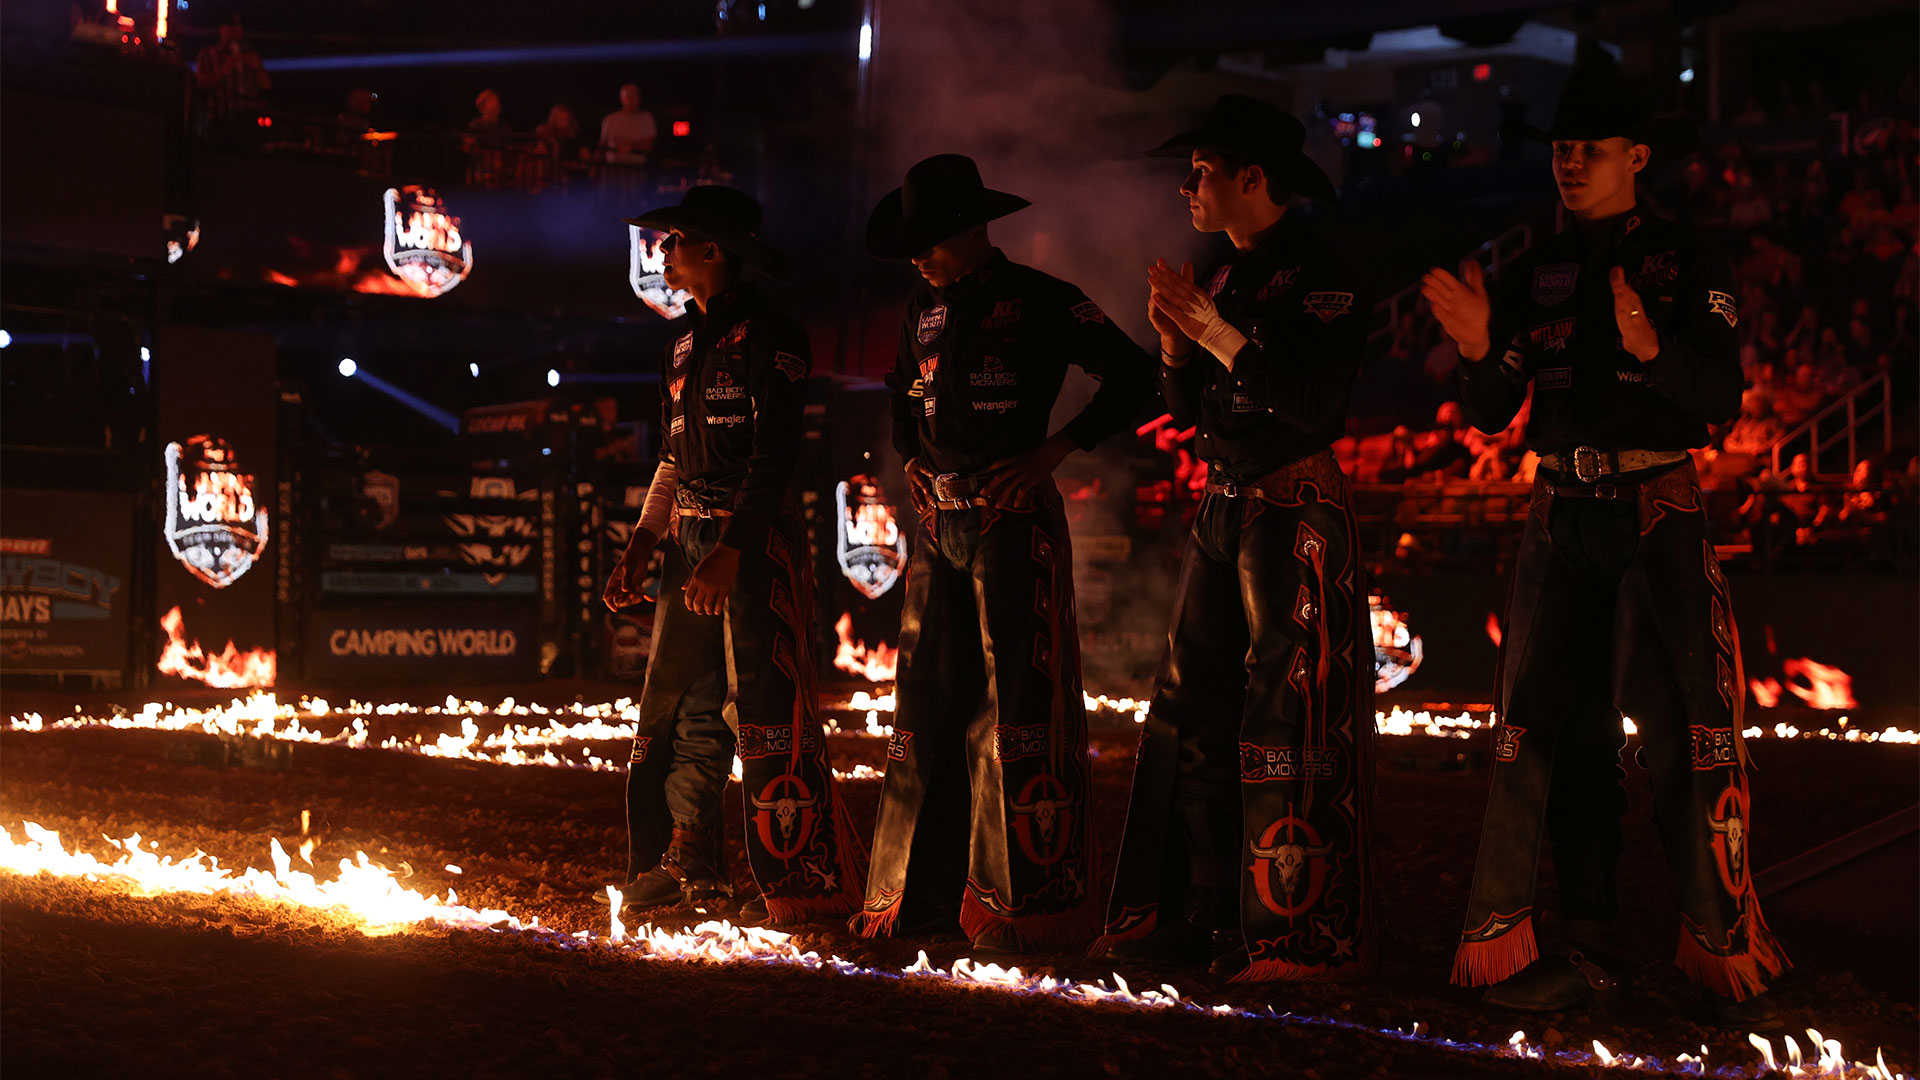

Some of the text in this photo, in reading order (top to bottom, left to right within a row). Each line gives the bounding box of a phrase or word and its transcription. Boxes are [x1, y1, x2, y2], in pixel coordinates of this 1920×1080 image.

[705, 386, 724, 394] BAD
[972, 400, 1019, 415] Wrangler
[706, 413, 747, 429] Wrangler
[179, 488, 255, 522] WORLD
[329, 628, 518, 657] CAMPING WORLD
[766, 728, 790, 739] BAD
[1266, 751, 1297, 762] BAD
[1266, 763, 1334, 776] MOWERS
